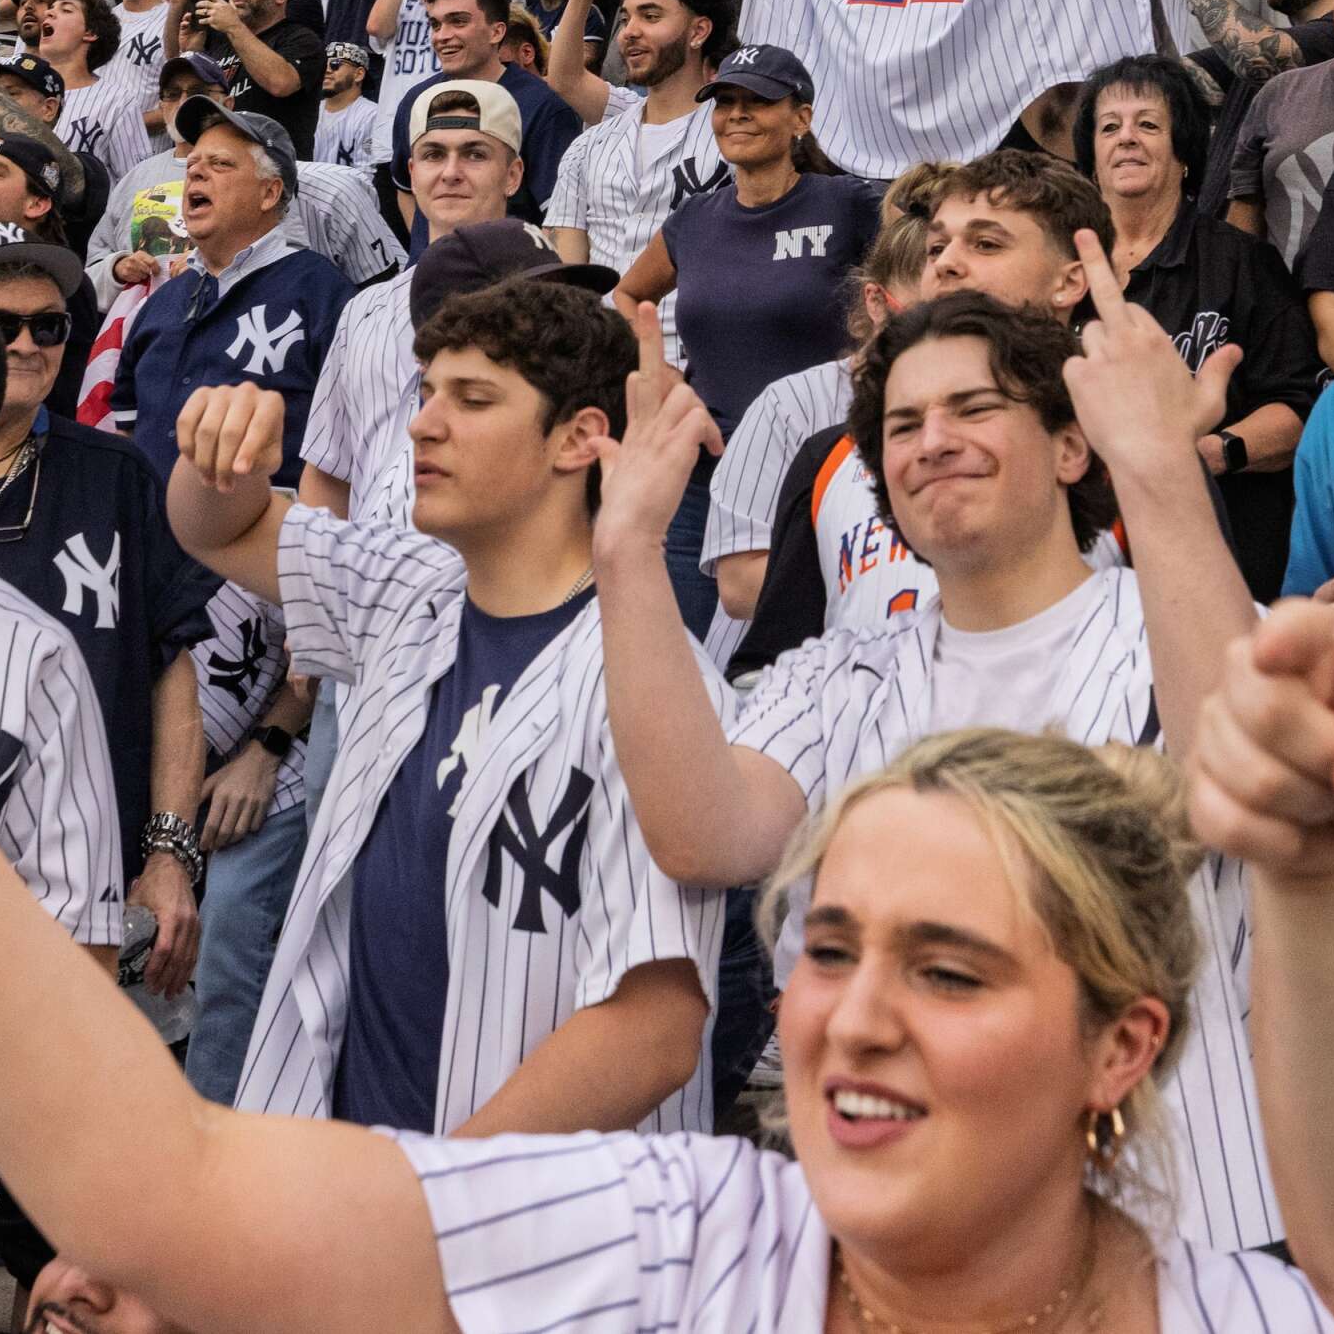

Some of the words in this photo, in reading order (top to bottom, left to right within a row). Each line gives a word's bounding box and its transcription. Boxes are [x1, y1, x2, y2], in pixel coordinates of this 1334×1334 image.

[126, 32, 161, 66] NY
[731, 47, 759, 65] NY
[68, 116, 104, 154] NY
[772, 224, 834, 261] NY
[225, 304, 306, 376] NY
[52, 531, 121, 629] NY
[481, 765, 596, 935] NY
